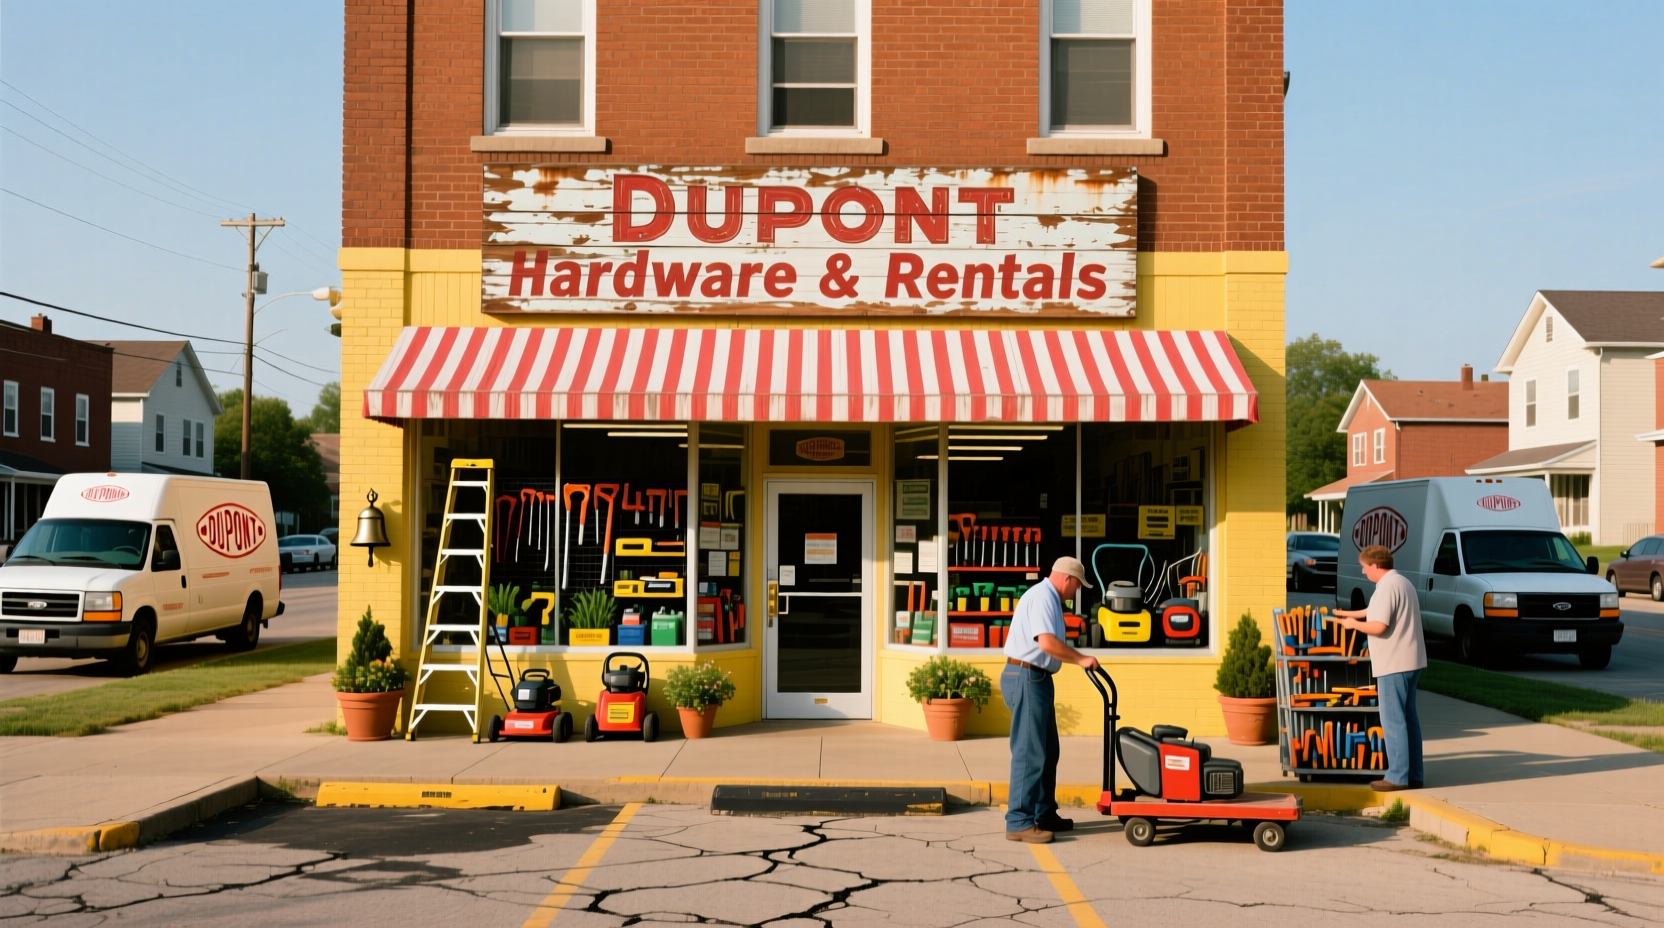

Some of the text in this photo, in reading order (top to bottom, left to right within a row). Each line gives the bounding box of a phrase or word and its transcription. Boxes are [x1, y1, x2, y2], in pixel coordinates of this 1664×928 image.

[612, 173, 1015, 244] DUPONT
[508, 249, 1107, 300] Hardware & Rentals
[208, 509, 257, 552] DUPONT
